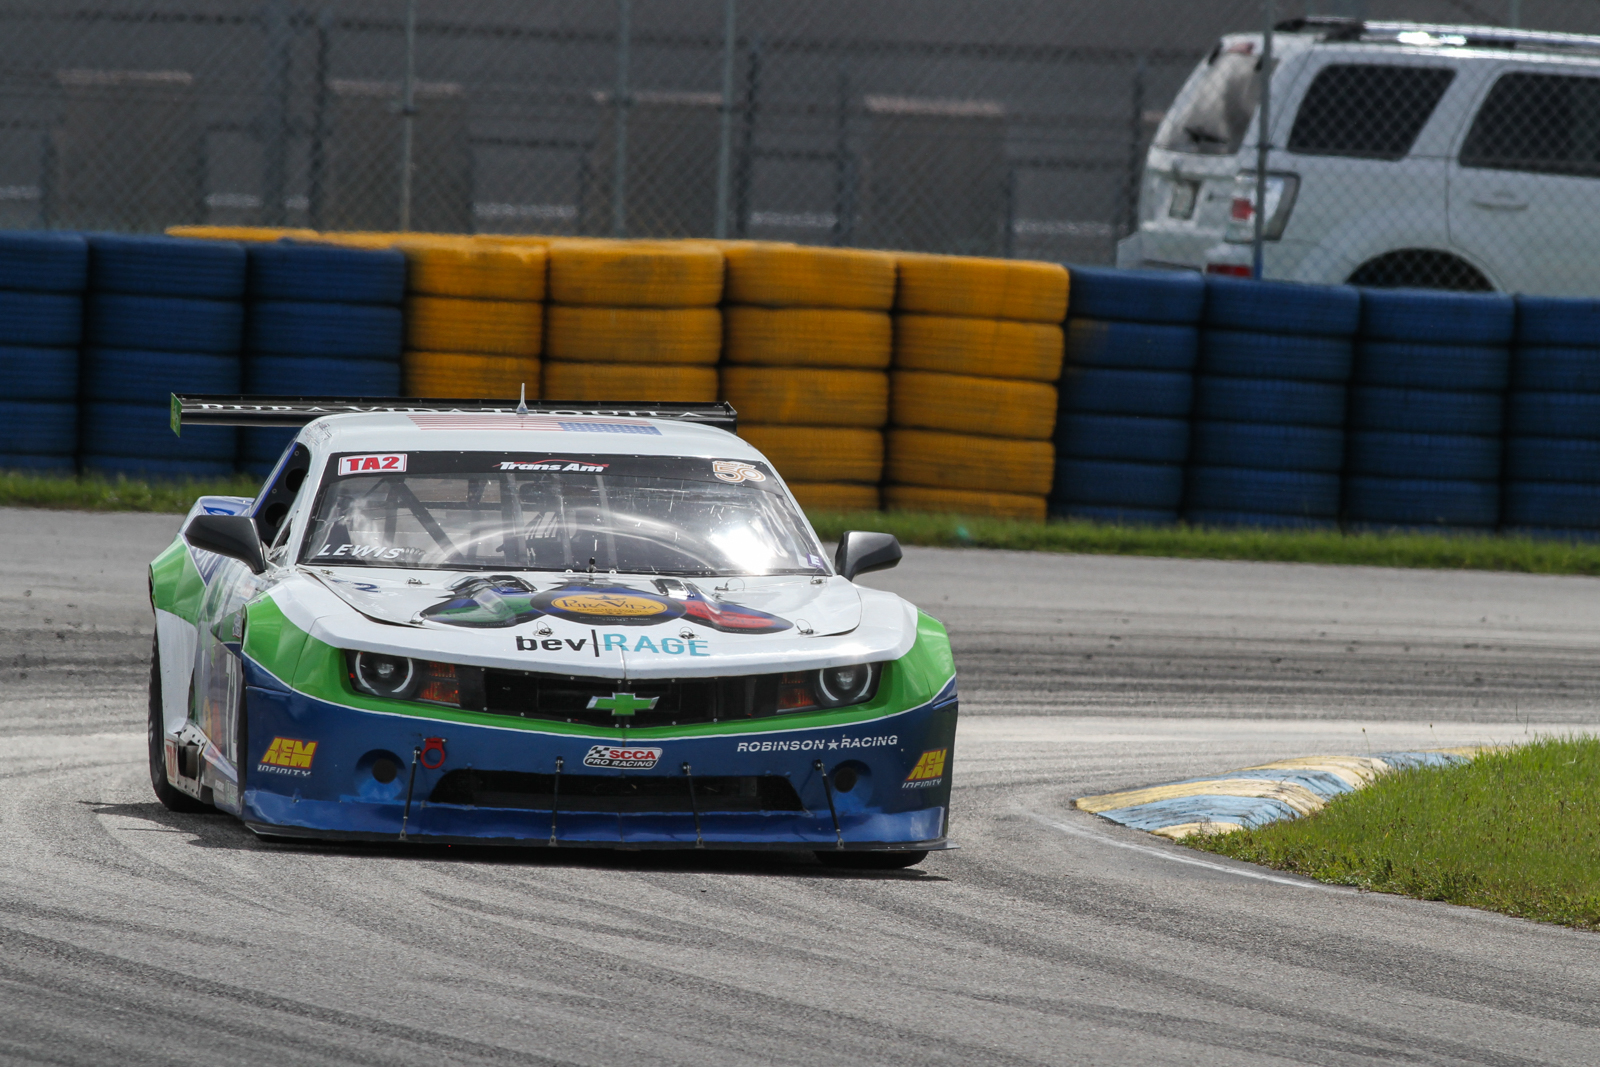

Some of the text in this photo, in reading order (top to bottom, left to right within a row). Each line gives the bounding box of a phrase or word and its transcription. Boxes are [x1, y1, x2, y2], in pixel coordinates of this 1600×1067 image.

[346, 456, 400, 471] TA2
[500, 461, 604, 473] Trans Am
[317, 543, 405, 559] LEWIS
[737, 735, 898, 752] ROBINSON RACING
[609, 749, 656, 760] SCCA
[586, 758, 654, 768] PRO RACING
[257, 764, 312, 777] INFINITY
[902, 778, 942, 789] INFINITY
